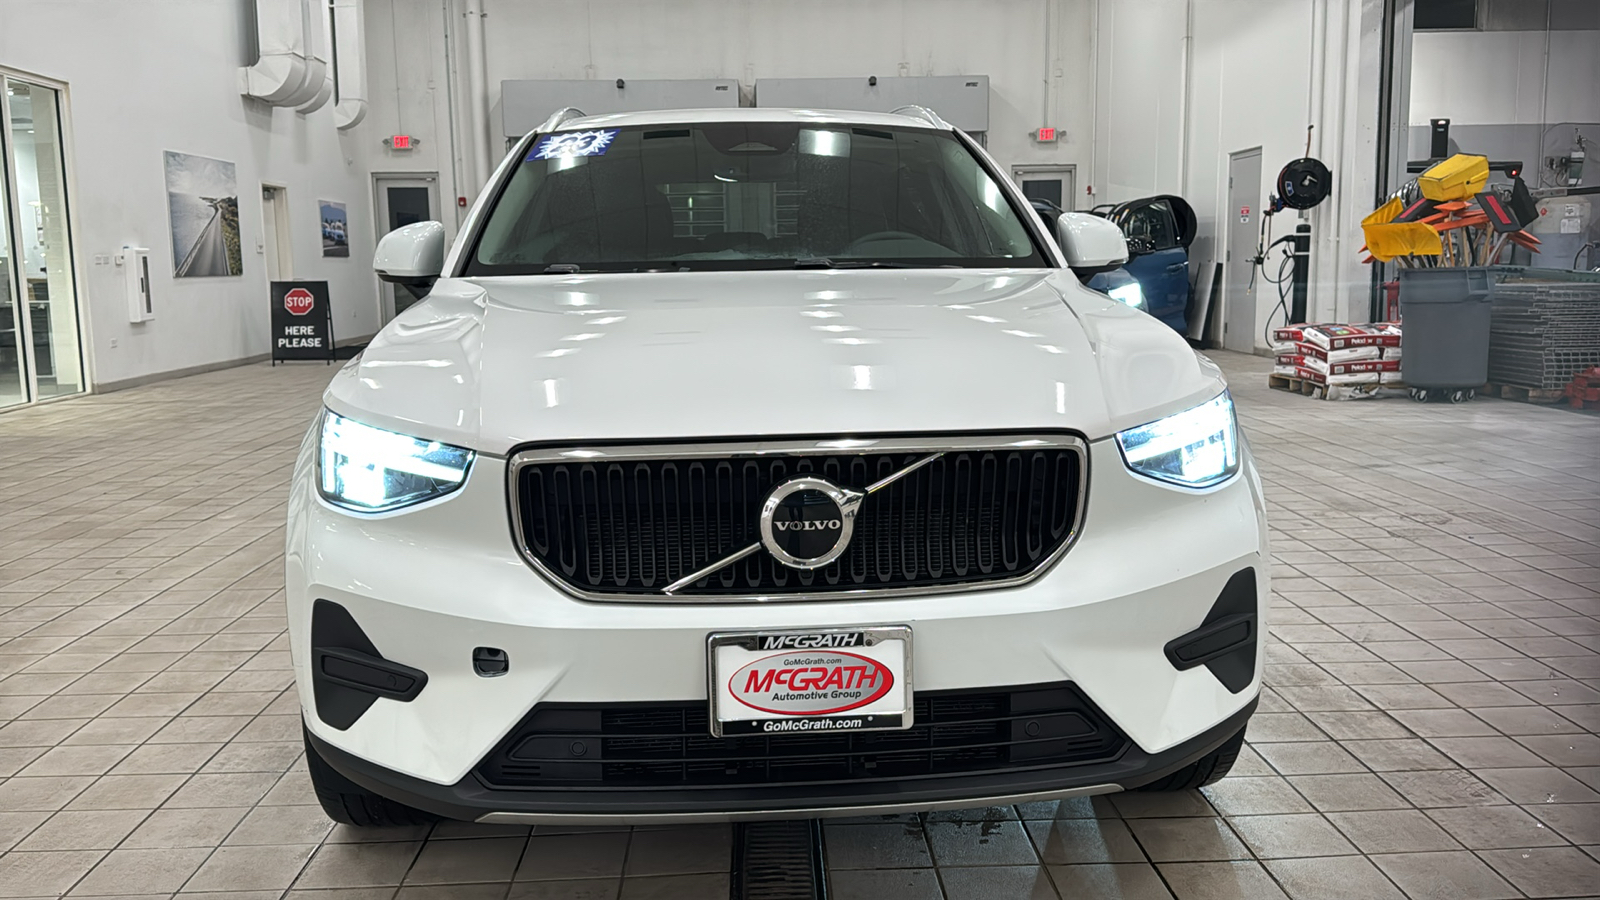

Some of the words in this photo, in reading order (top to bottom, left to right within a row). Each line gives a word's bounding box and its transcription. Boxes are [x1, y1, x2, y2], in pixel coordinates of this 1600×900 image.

[286, 296, 312, 307] STOP
[284, 325, 315, 336] HERE
[277, 337, 322, 348] PLEASE
[774, 519, 841, 531] VOLVO
[783, 657, 842, 666] GoMcGrath.com
[772, 691, 829, 701] Automotive
[831, 690, 862, 700] Group
[763, 718, 862, 732] GoMcGrath.com
